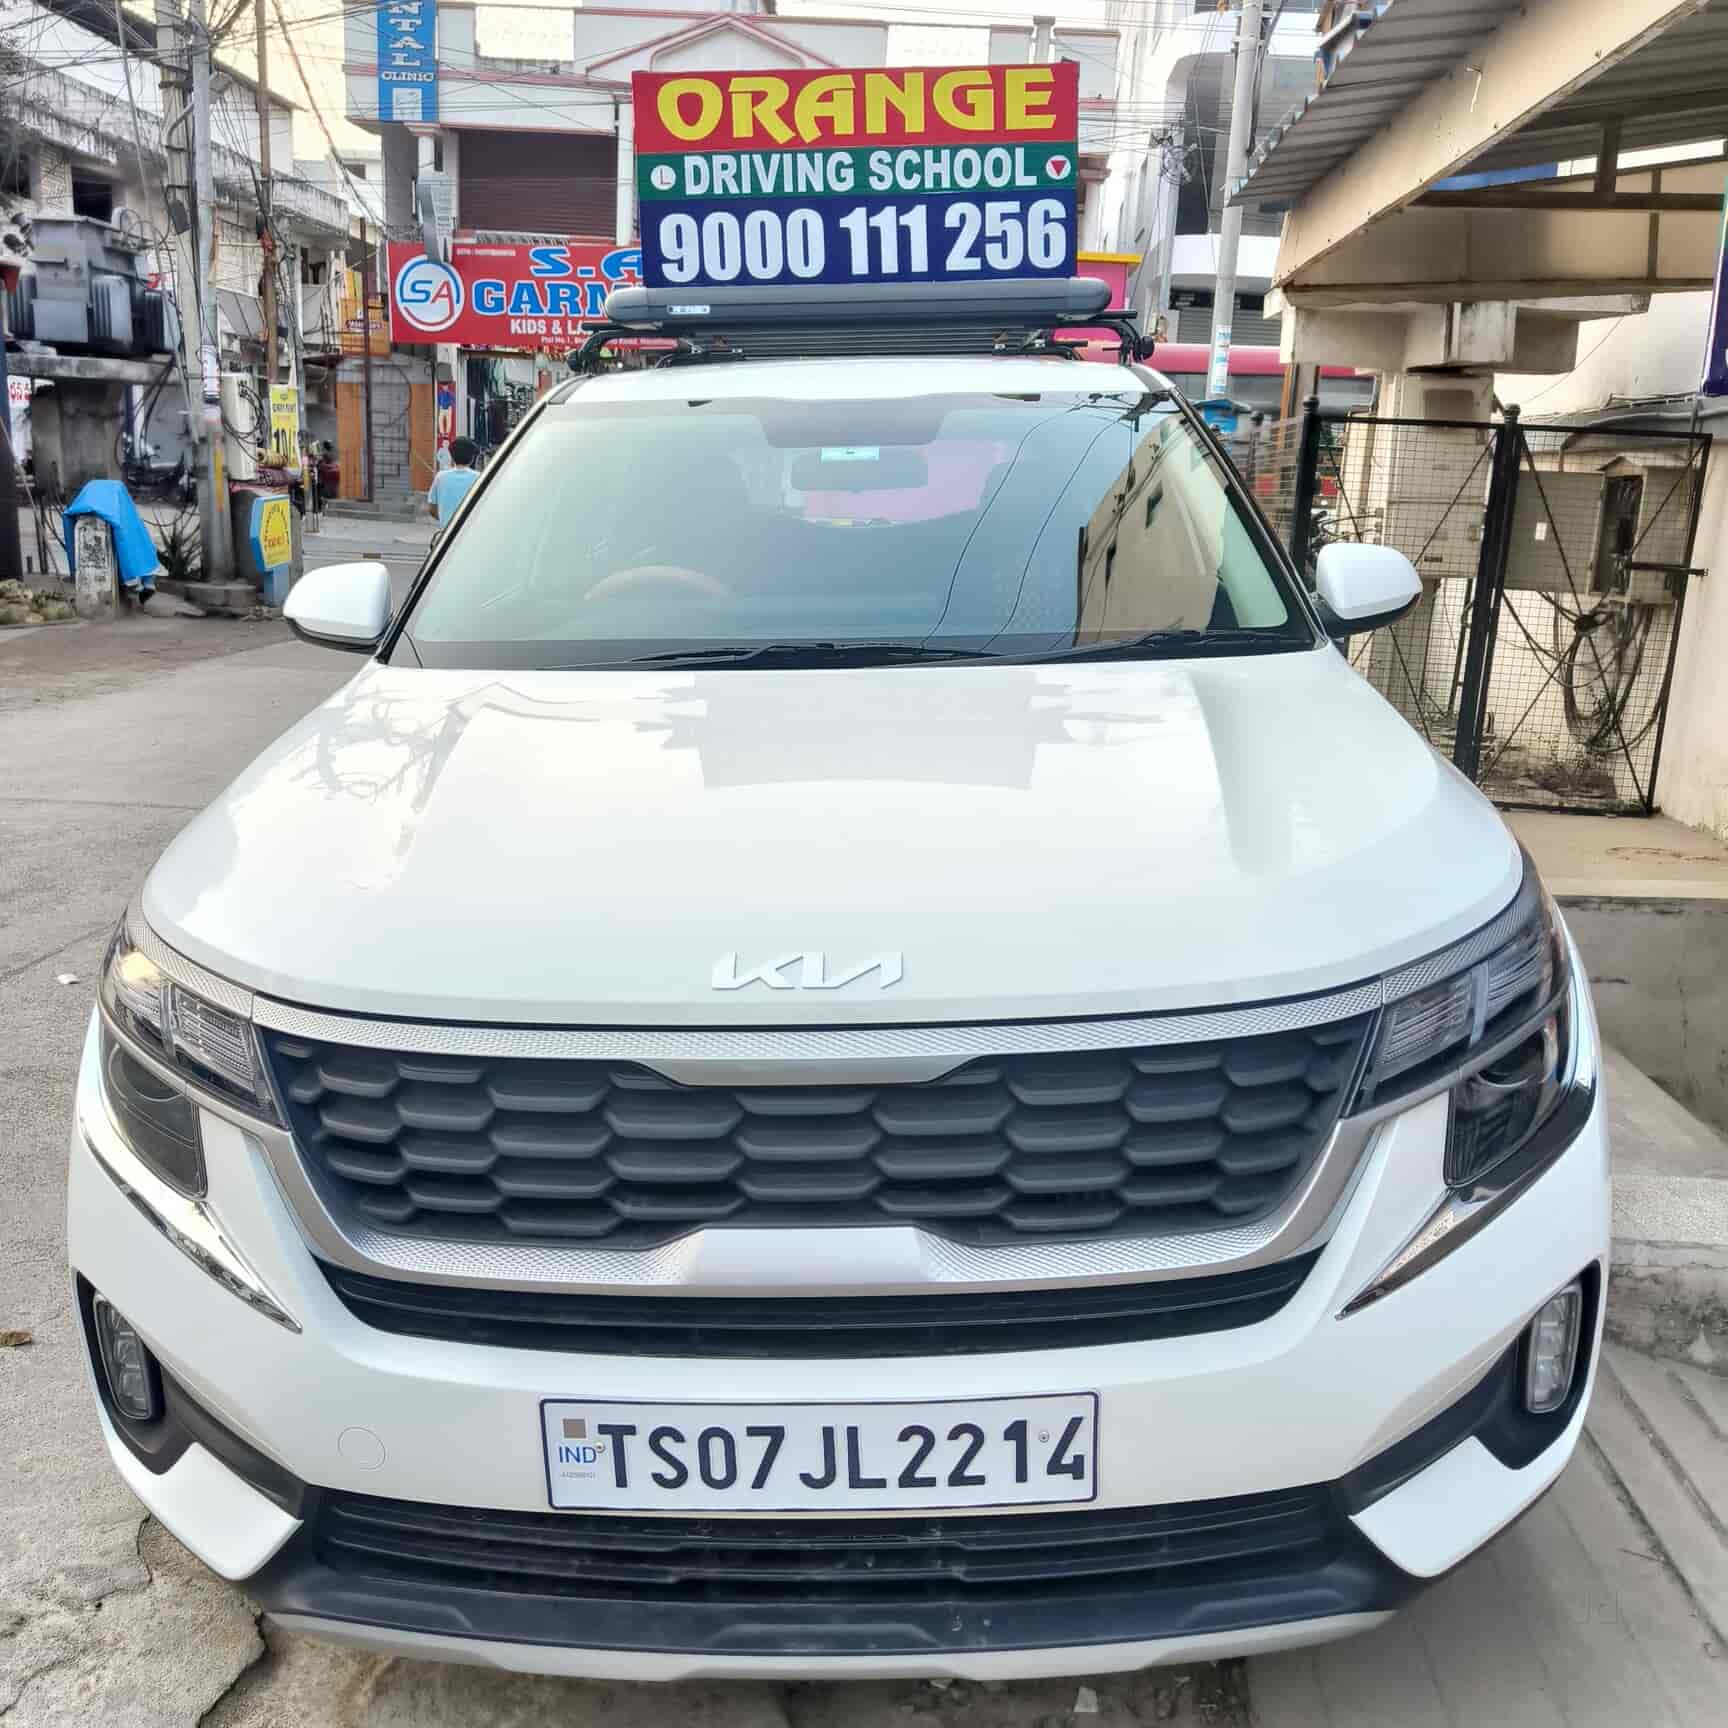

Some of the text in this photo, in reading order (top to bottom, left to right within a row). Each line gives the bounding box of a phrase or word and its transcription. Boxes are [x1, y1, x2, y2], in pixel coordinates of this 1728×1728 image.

[382, 71, 434, 81] CLINIC
[657, 68, 1057, 144] ORANGE
[684, 150, 855, 195] DRIVING
[869, 147, 1037, 190] SCHOOL
[659, 199, 1067, 283] 9000 111 256
[401, 280, 454, 304] SA
[511, 319, 546, 334] KIDS
[551, 319, 562, 334] &
[711, 952, 903, 990] KIA
[559, 1446, 597, 1463] IND
